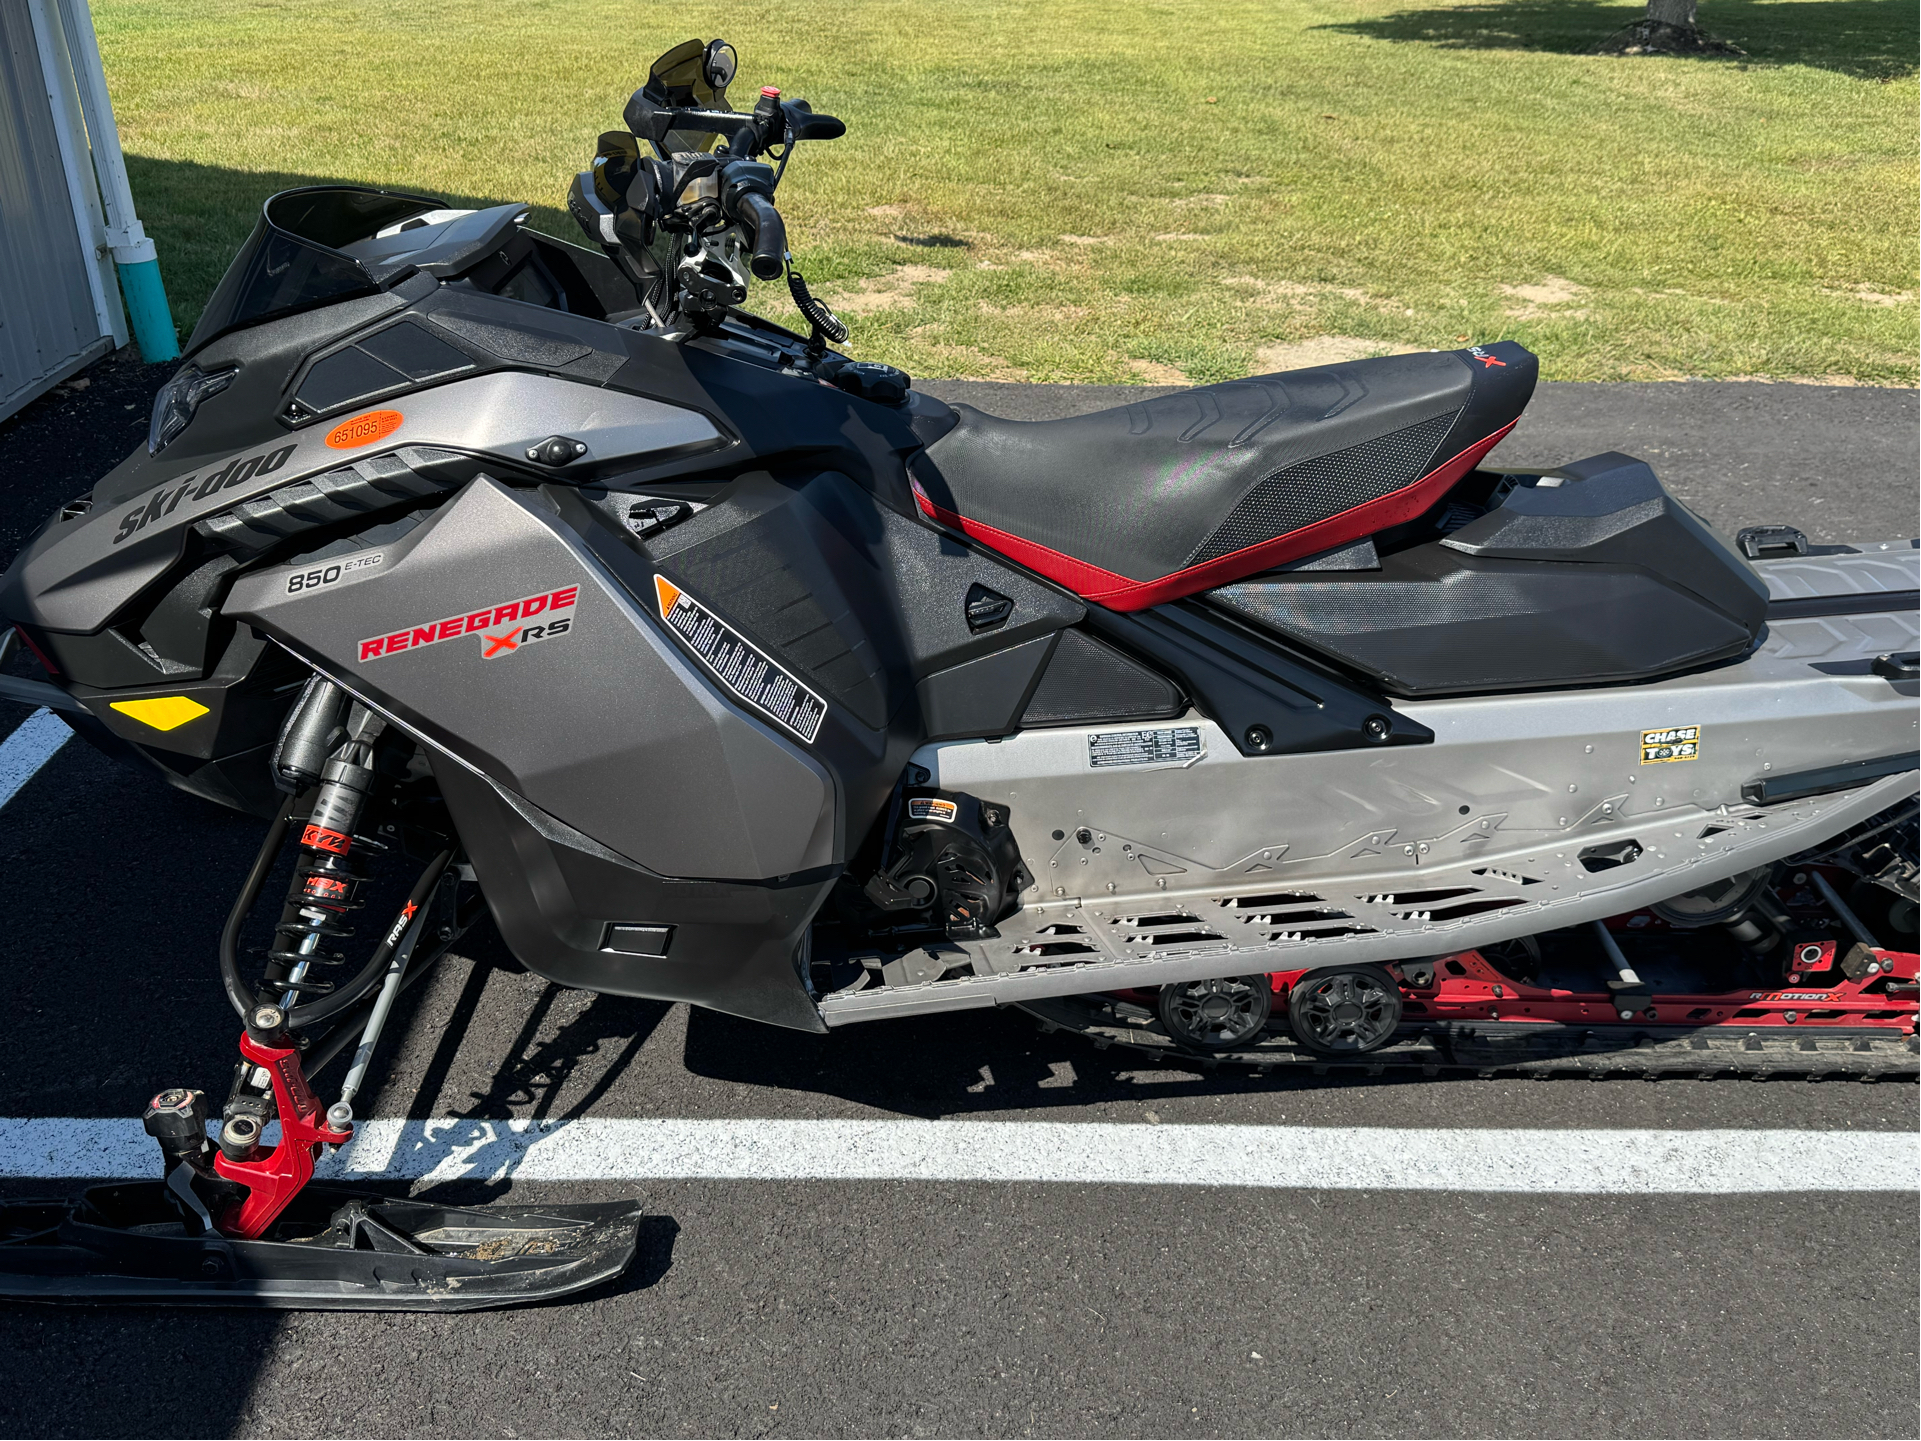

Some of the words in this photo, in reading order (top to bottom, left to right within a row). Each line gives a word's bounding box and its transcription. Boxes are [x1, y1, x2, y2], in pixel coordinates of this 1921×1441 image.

[334, 420, 378, 444] 651095
[288, 565, 342, 593] 850
[344, 555, 382, 571] E-TEC
[360, 586, 579, 661] RENEGADE
[1645, 728, 1696, 744] CHASE
[303, 828, 347, 850] KYB
